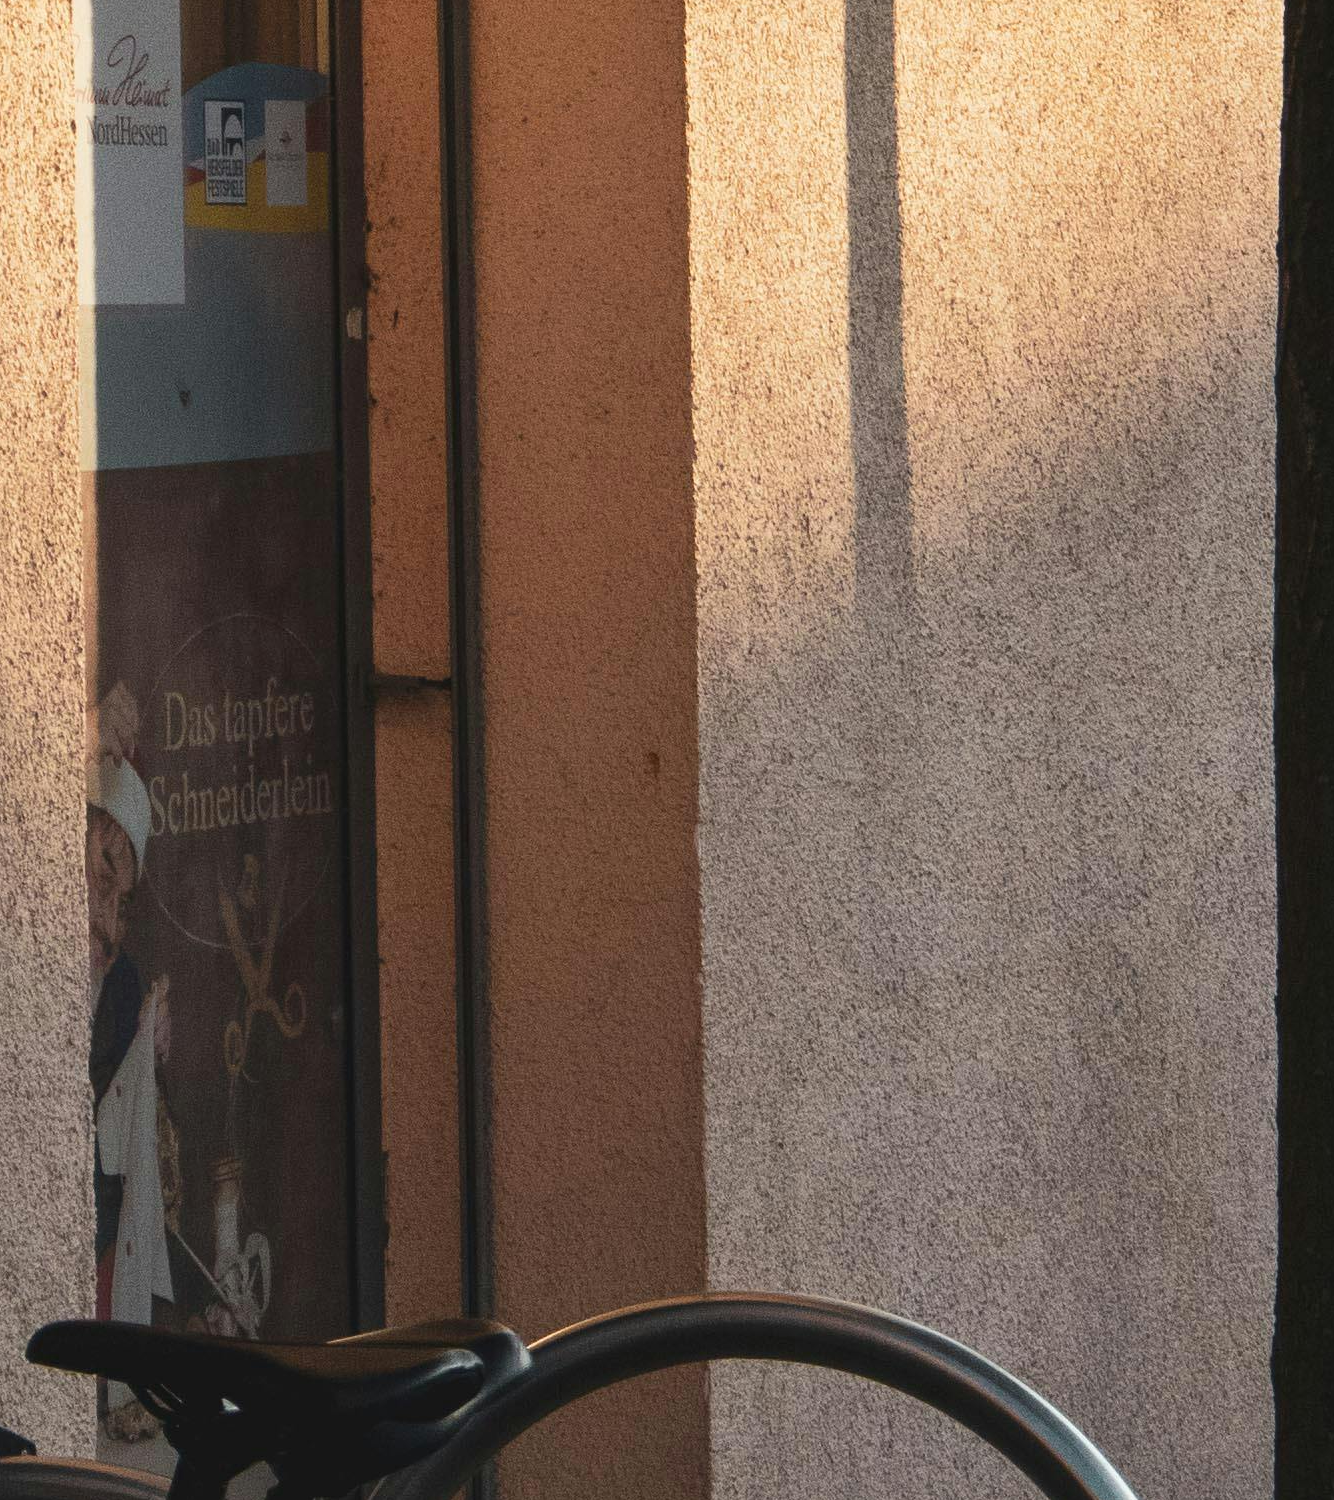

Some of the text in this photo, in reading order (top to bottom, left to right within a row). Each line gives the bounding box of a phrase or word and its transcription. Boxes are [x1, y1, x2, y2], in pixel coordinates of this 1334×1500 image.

[90, 115, 168, 147] NordHessen
[163, 676, 315, 758] Das tapfere
[149, 753, 333, 837] Schneiderlein
